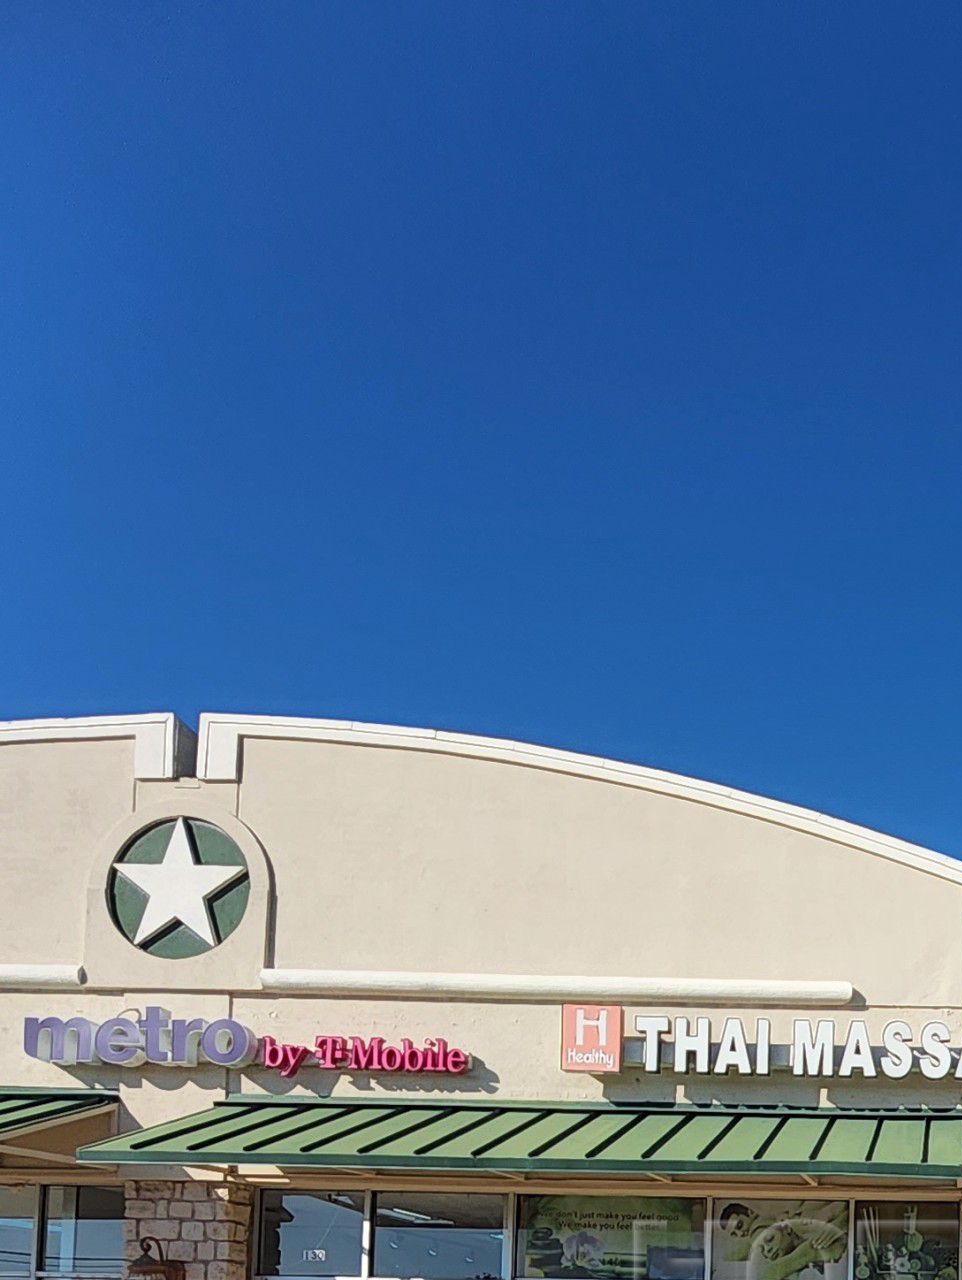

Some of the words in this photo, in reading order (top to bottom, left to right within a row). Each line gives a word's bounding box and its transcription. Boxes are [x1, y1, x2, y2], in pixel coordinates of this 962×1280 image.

[575, 1008, 607, 1046] H
[24, 1006, 248, 1064] metro
[265, 1036, 303, 1077] by
[635, 1015, 769, 1074] THAI
[567, 1047, 613, 1068] Healthy
[579, 1212, 595, 1221] just
[639, 1212, 655, 1220] feel
[617, 1222, 632, 1230] feel
[305, 1251, 324, 1261] 130
